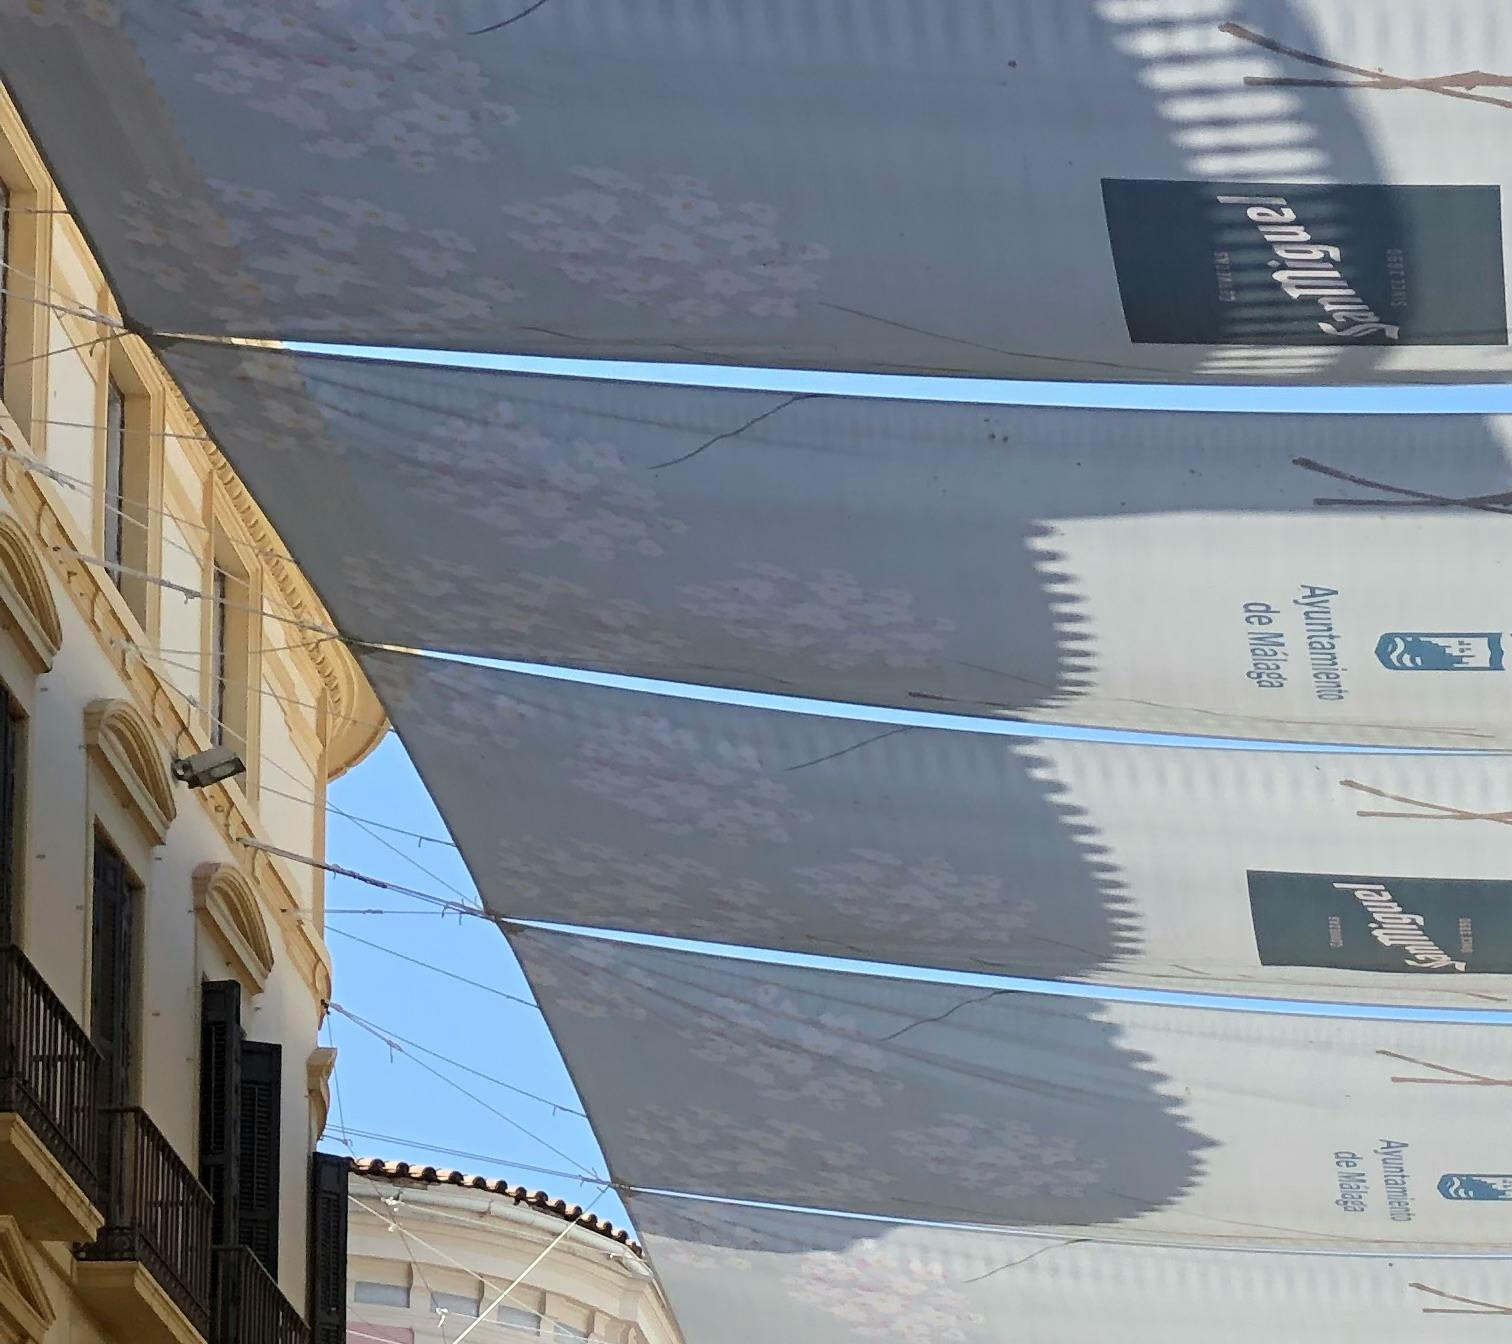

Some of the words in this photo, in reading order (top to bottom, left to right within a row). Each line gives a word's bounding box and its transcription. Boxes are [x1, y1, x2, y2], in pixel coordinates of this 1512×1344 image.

[1242, 602, 1281, 626] de
[1246, 631, 1289, 689] Málaga
[1292, 584, 1349, 700] Ayuntamiento
[1334, 1151, 1364, 1169] de
[1373, 1138, 1416, 1223] Ayuntamiento
[1335, 1171, 1370, 1213] Málaga
